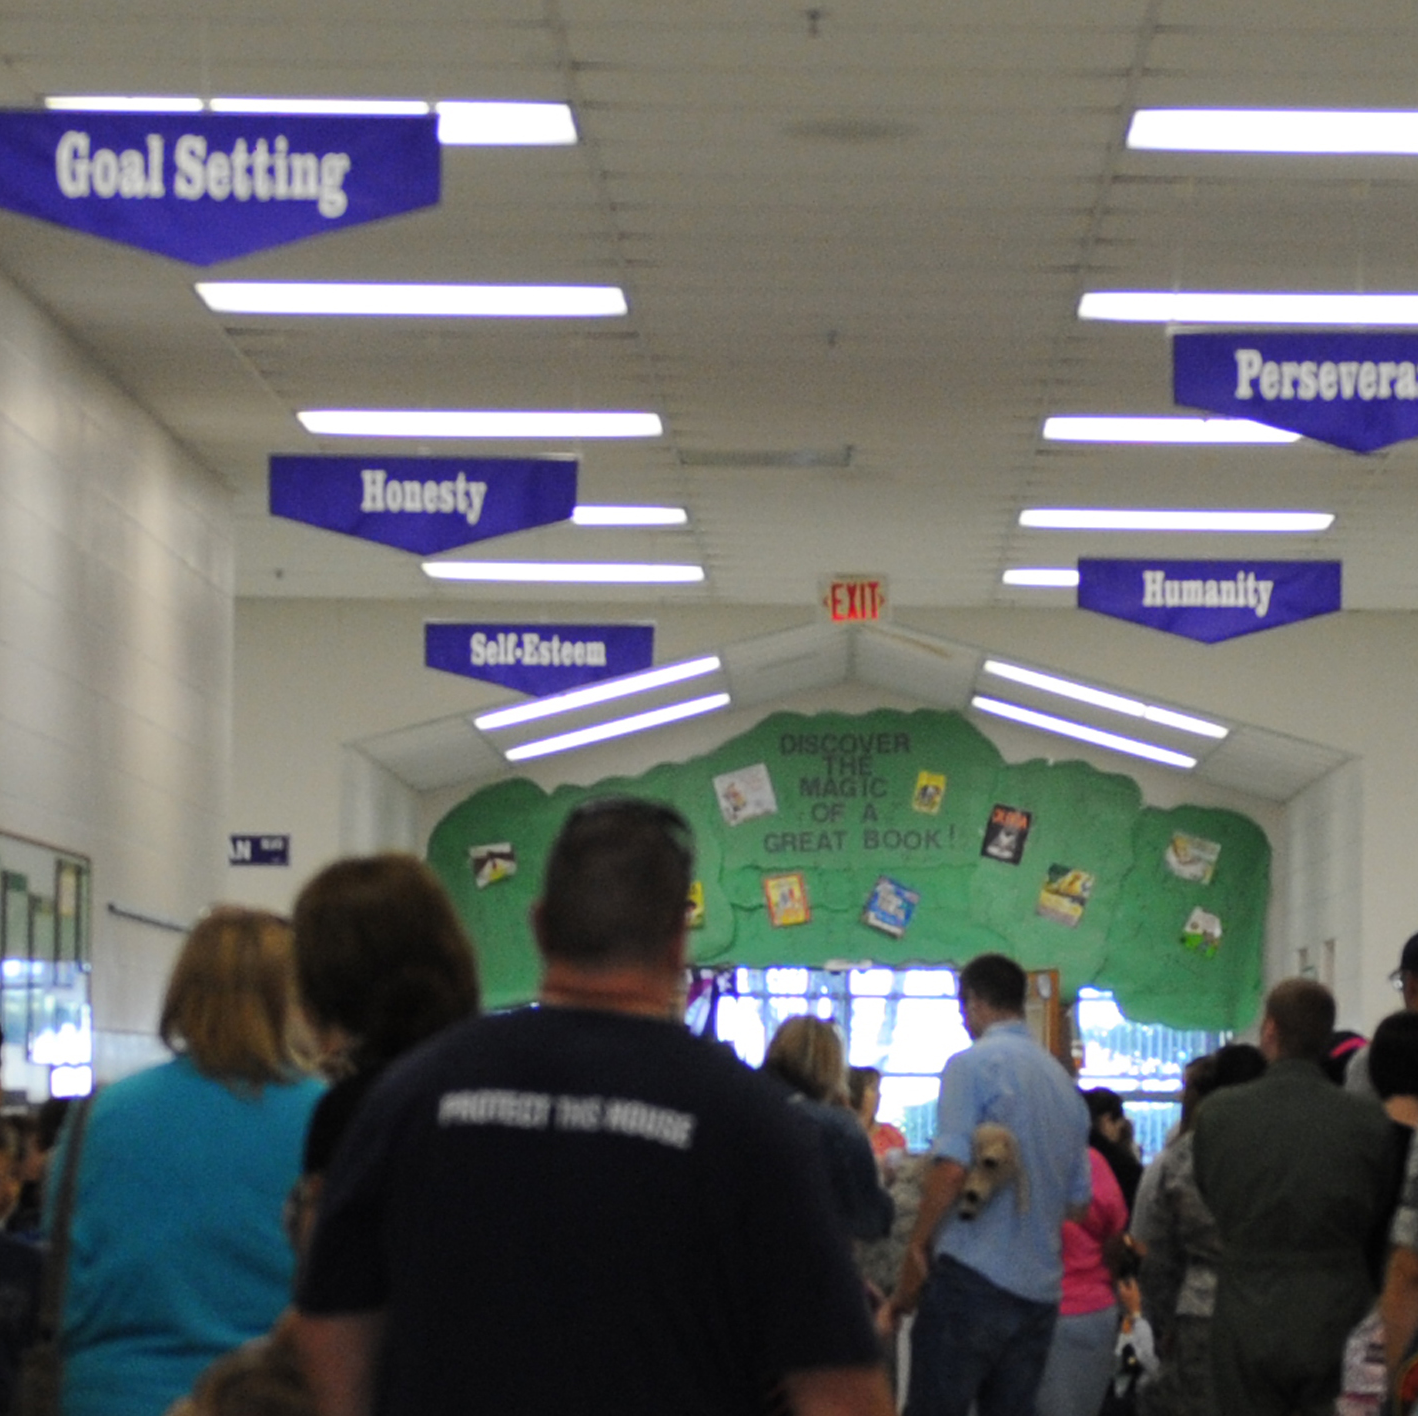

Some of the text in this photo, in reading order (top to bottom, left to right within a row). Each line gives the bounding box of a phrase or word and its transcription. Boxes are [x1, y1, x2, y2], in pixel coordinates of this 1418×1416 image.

[55, 130, 352, 219] Goal Setting
[360, 468, 488, 526] Honesty
[830, 582, 880, 620] EXIT
[1141, 568, 1275, 619] Humanity
[468, 631, 608, 669] Self-Esteem
[781, 733, 910, 755] DISCOVER
[823, 754, 873, 776] THE
[799, 776, 888, 798] MAGIC
[811, 803, 879, 823] OF A
[764, 831, 848, 853] GREAT
[438, 1088, 552, 1130] PROTECT
